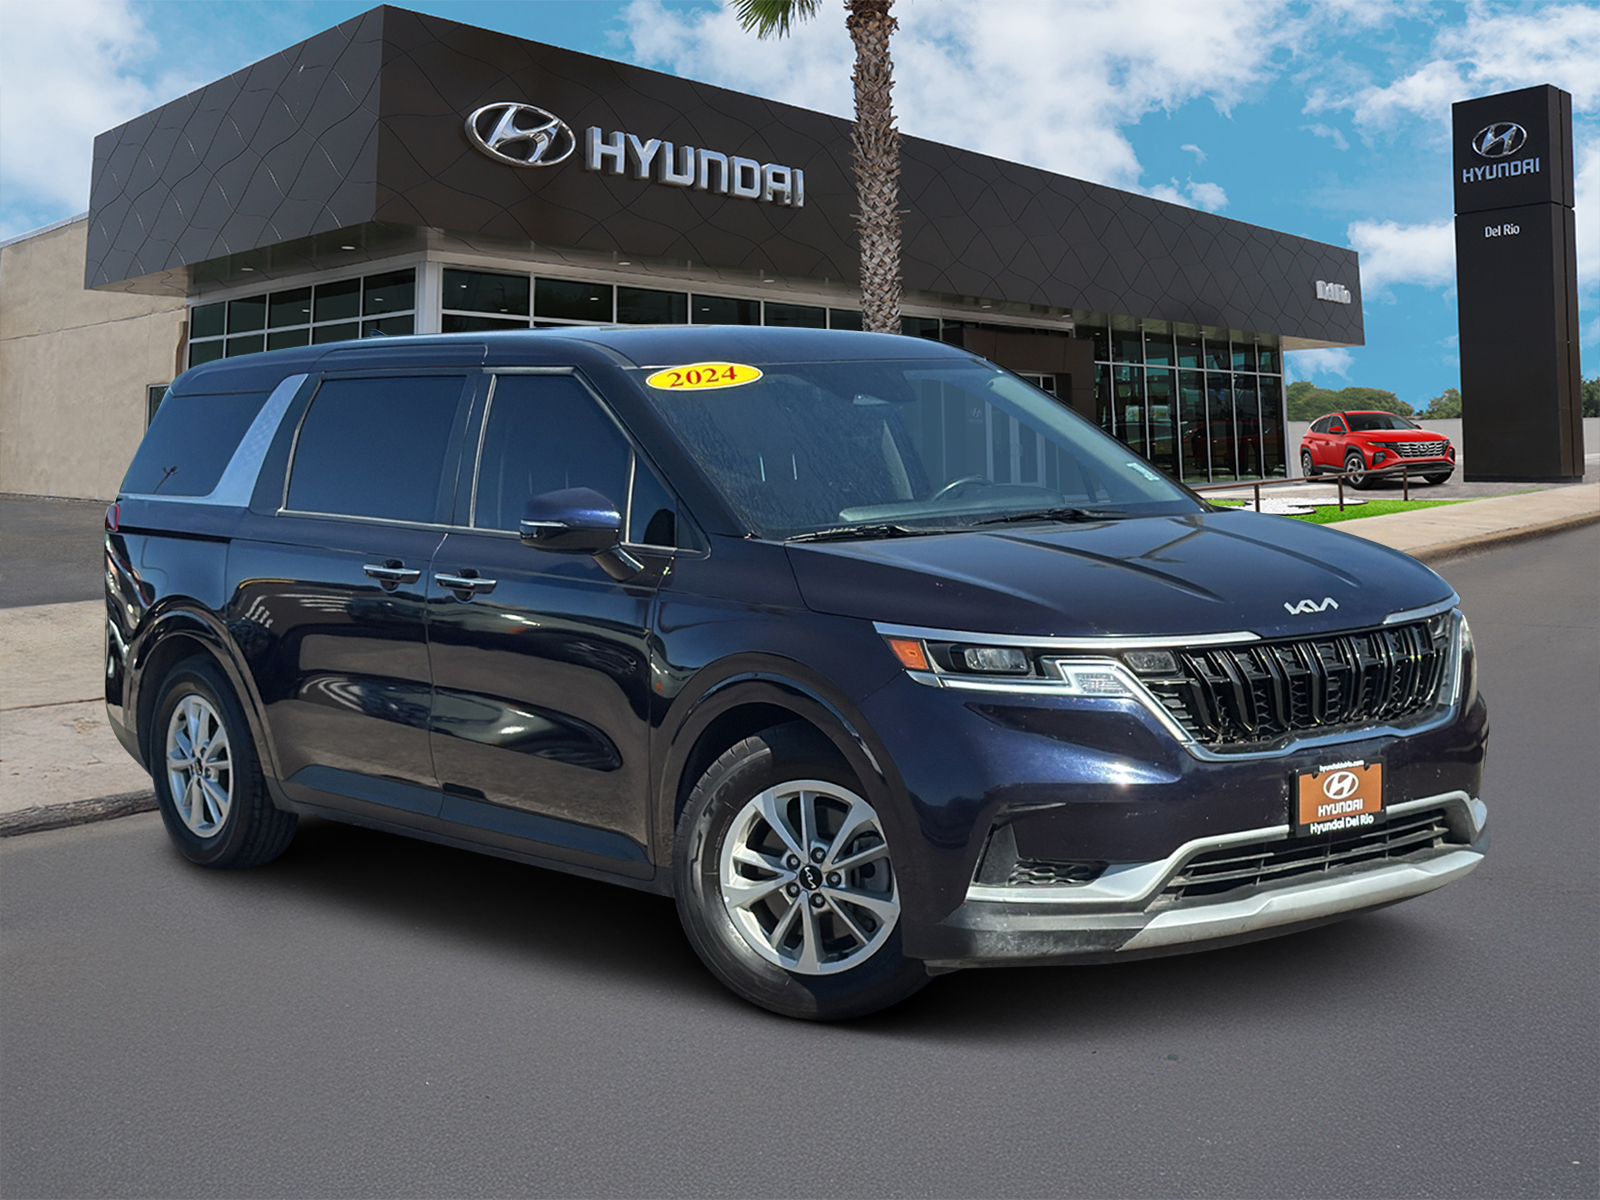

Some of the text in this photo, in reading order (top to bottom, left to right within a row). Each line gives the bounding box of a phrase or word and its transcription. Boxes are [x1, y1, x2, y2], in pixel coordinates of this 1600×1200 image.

[585, 125, 804, 207] HYUNDAI
[1462, 157, 1540, 184] HYUNDAI
[1484, 223, 1520, 238] Del Rio
[667, 365, 738, 388] 2024
[1318, 798, 1364, 817] HYUNDAI
[1310, 813, 1374, 835] Hyundai Del Rio
